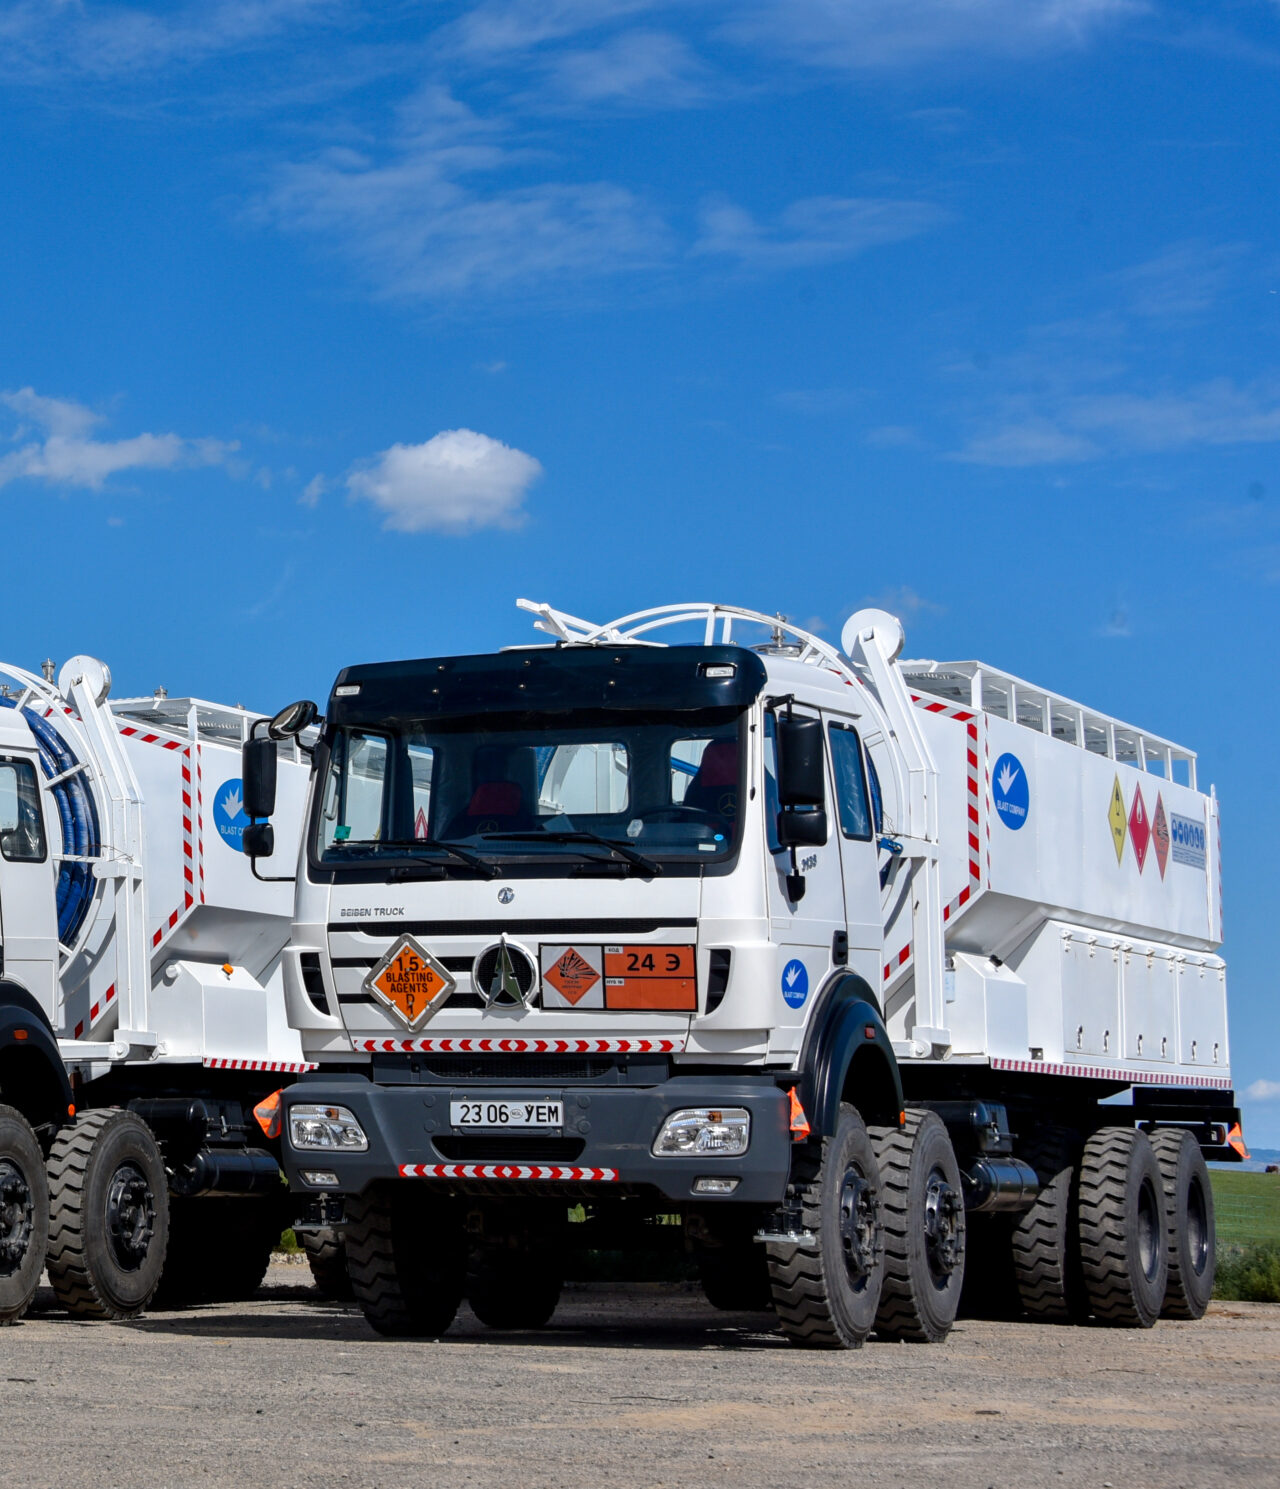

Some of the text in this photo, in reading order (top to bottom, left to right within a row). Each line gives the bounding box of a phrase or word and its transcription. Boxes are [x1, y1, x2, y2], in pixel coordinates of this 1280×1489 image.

[220, 824, 238, 836] BLAST
[340, 907, 405, 917] BEIBEN TRUCK
[626, 953, 681, 972] 24 Э
[385, 972, 433, 983] BLASTING
[390, 983, 428, 993] AGENTS
